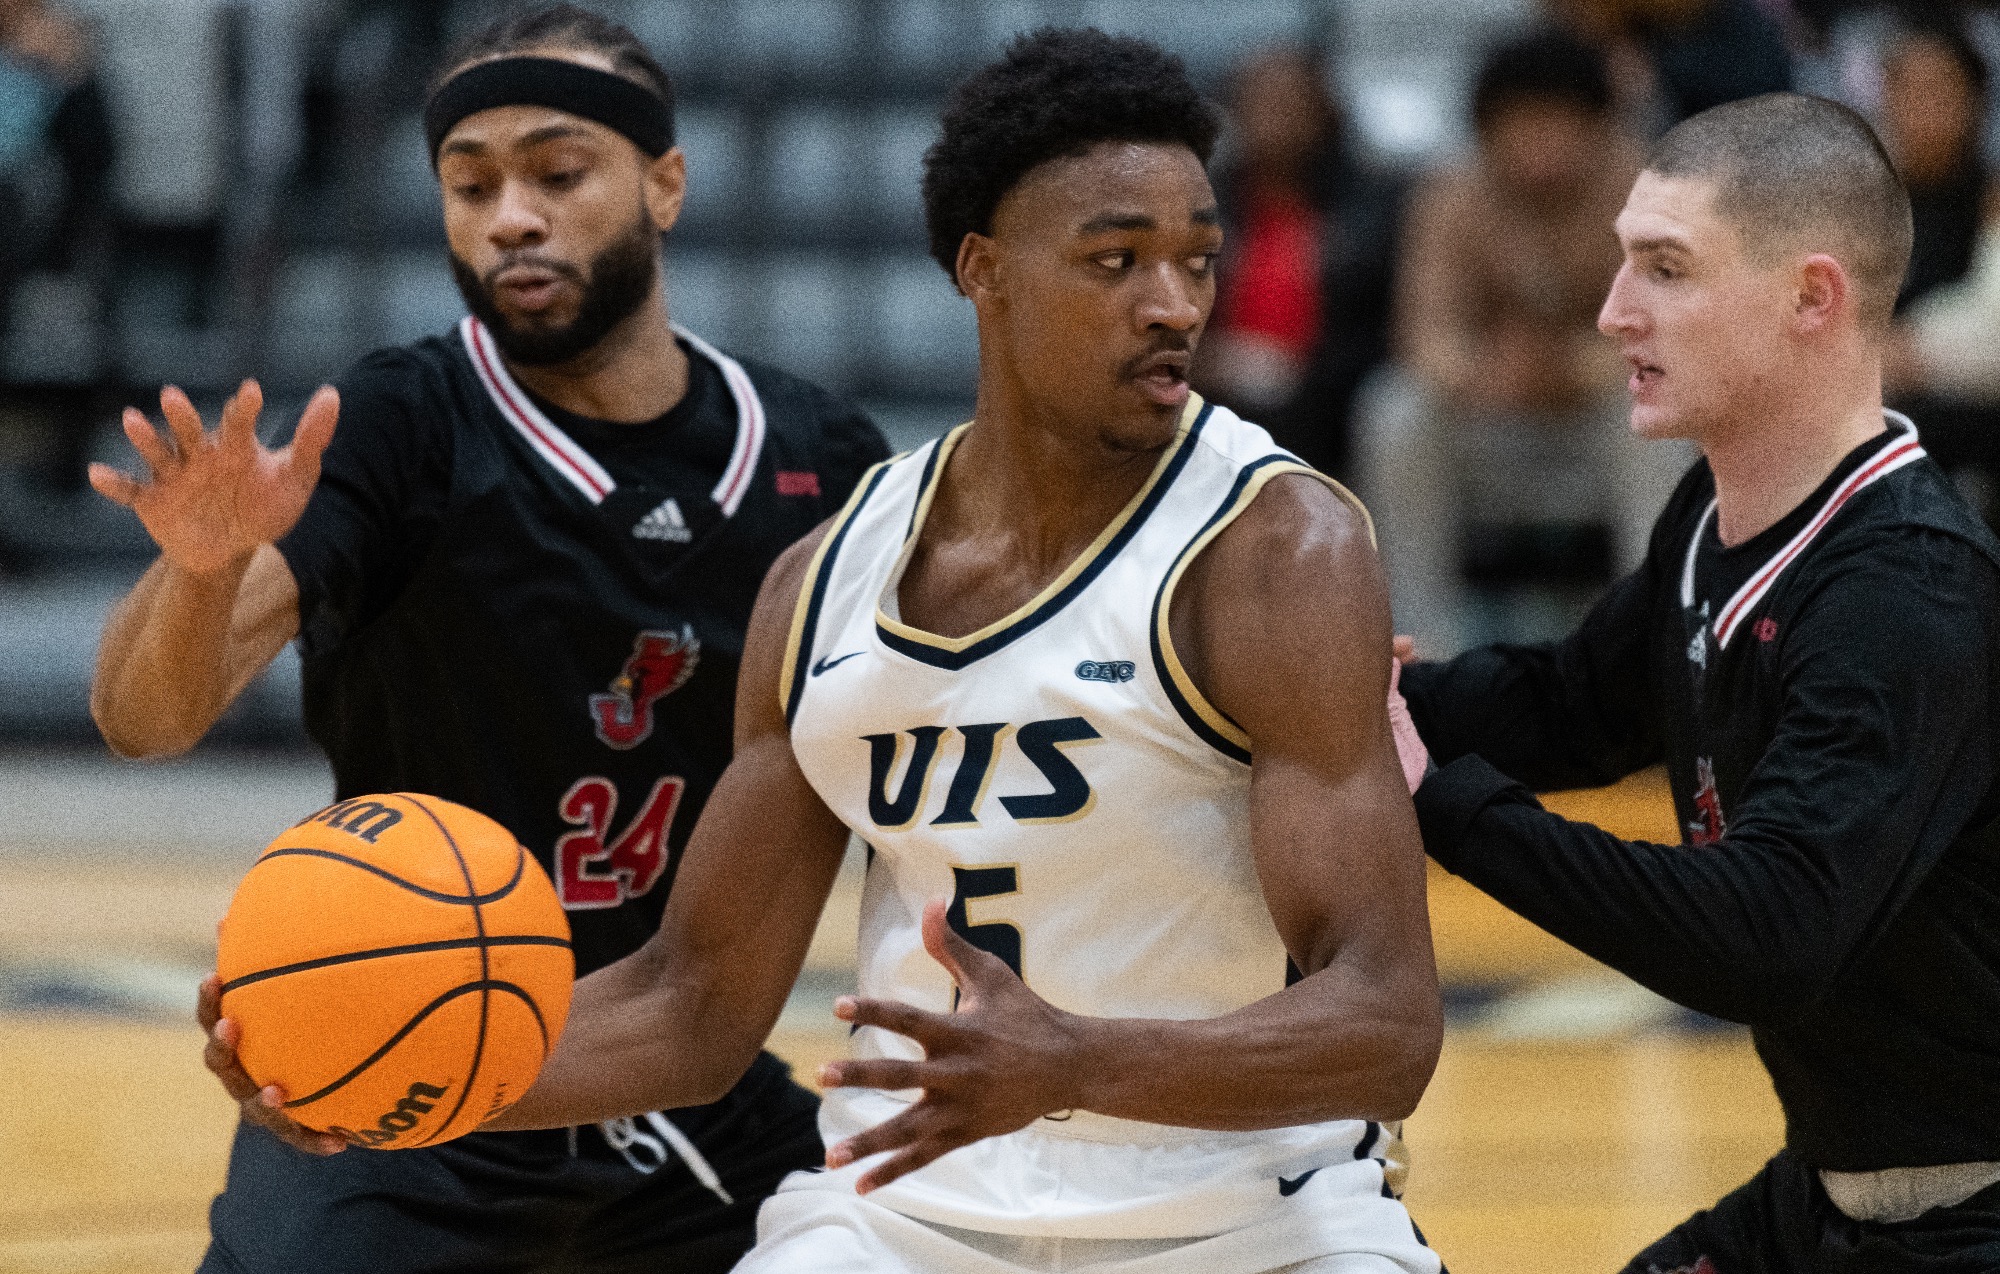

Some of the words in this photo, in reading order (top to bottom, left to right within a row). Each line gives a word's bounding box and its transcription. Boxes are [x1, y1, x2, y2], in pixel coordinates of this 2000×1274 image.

[858, 716, 1103, 833] UIS
[554, 776, 686, 911] 24
[946, 862, 1030, 1014] 5
